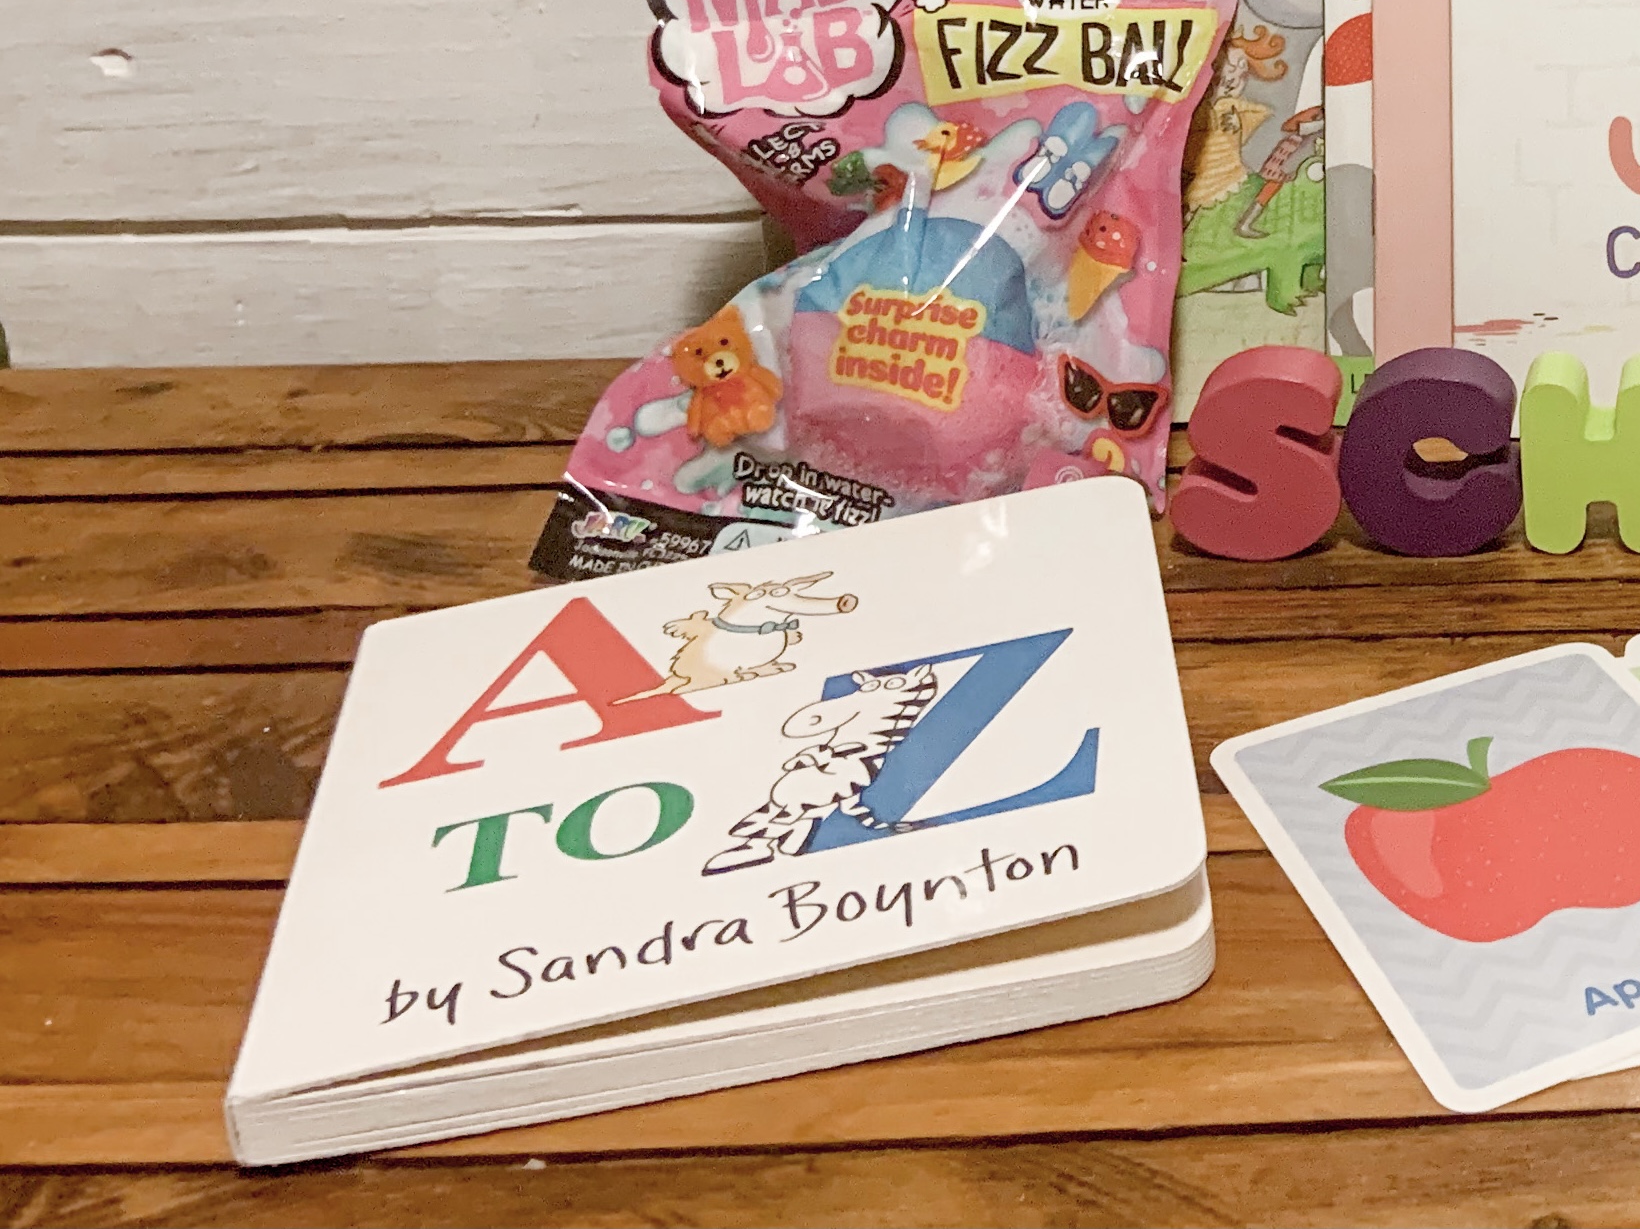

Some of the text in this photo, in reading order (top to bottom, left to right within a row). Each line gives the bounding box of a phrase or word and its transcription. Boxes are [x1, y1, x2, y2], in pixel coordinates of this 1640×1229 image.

[711, 7, 875, 105] LAB
[937, 18, 1193, 92] FIZZ BALL
[846, 291, 978, 329] Surprise
[847, 318, 958, 361] charm
[835, 346, 961, 405] inside!
[737, 455, 794, 487] Drop
[800, 465, 818, 486] in
[569, 555, 616, 573] MADE
[379, 597, 721, 789] A
[805, 627, 1100, 855] Z
[433, 780, 695, 894] TO
[380, 842, 1080, 1024] by Sandra Boynton
